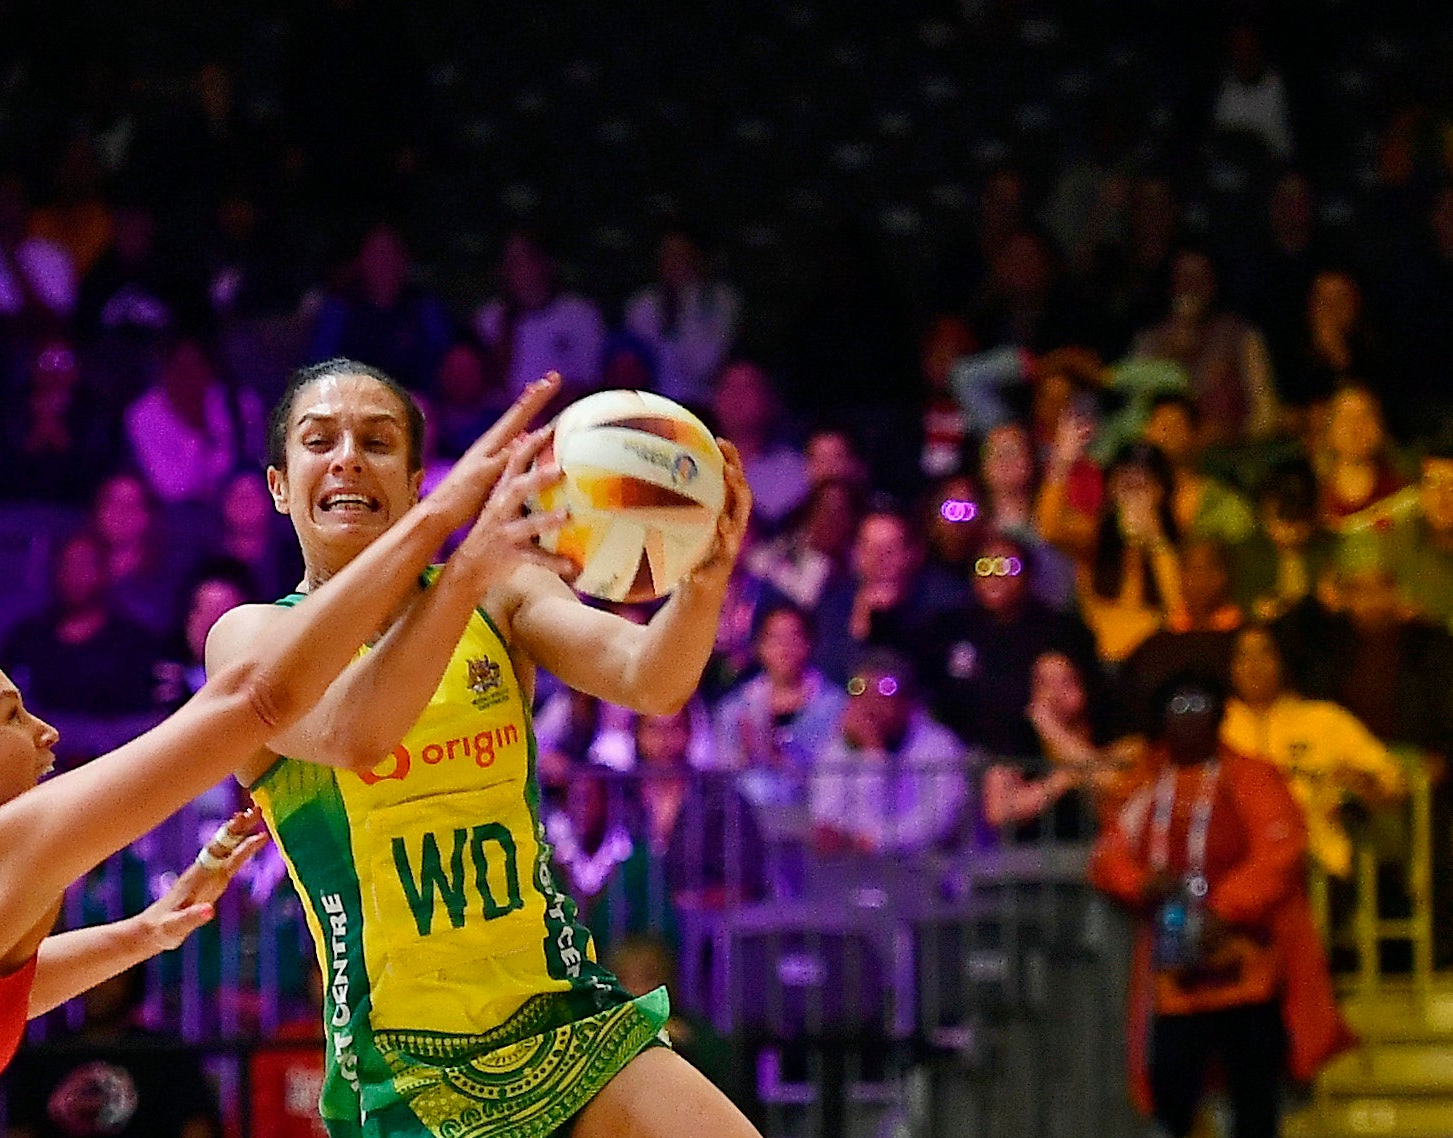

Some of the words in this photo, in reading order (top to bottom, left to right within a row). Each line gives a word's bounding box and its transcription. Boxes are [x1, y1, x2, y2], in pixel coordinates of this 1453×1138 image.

[421, 723, 518, 768] origin
[391, 821, 525, 937] WD
[320, 893, 352, 1028] CENTRE
